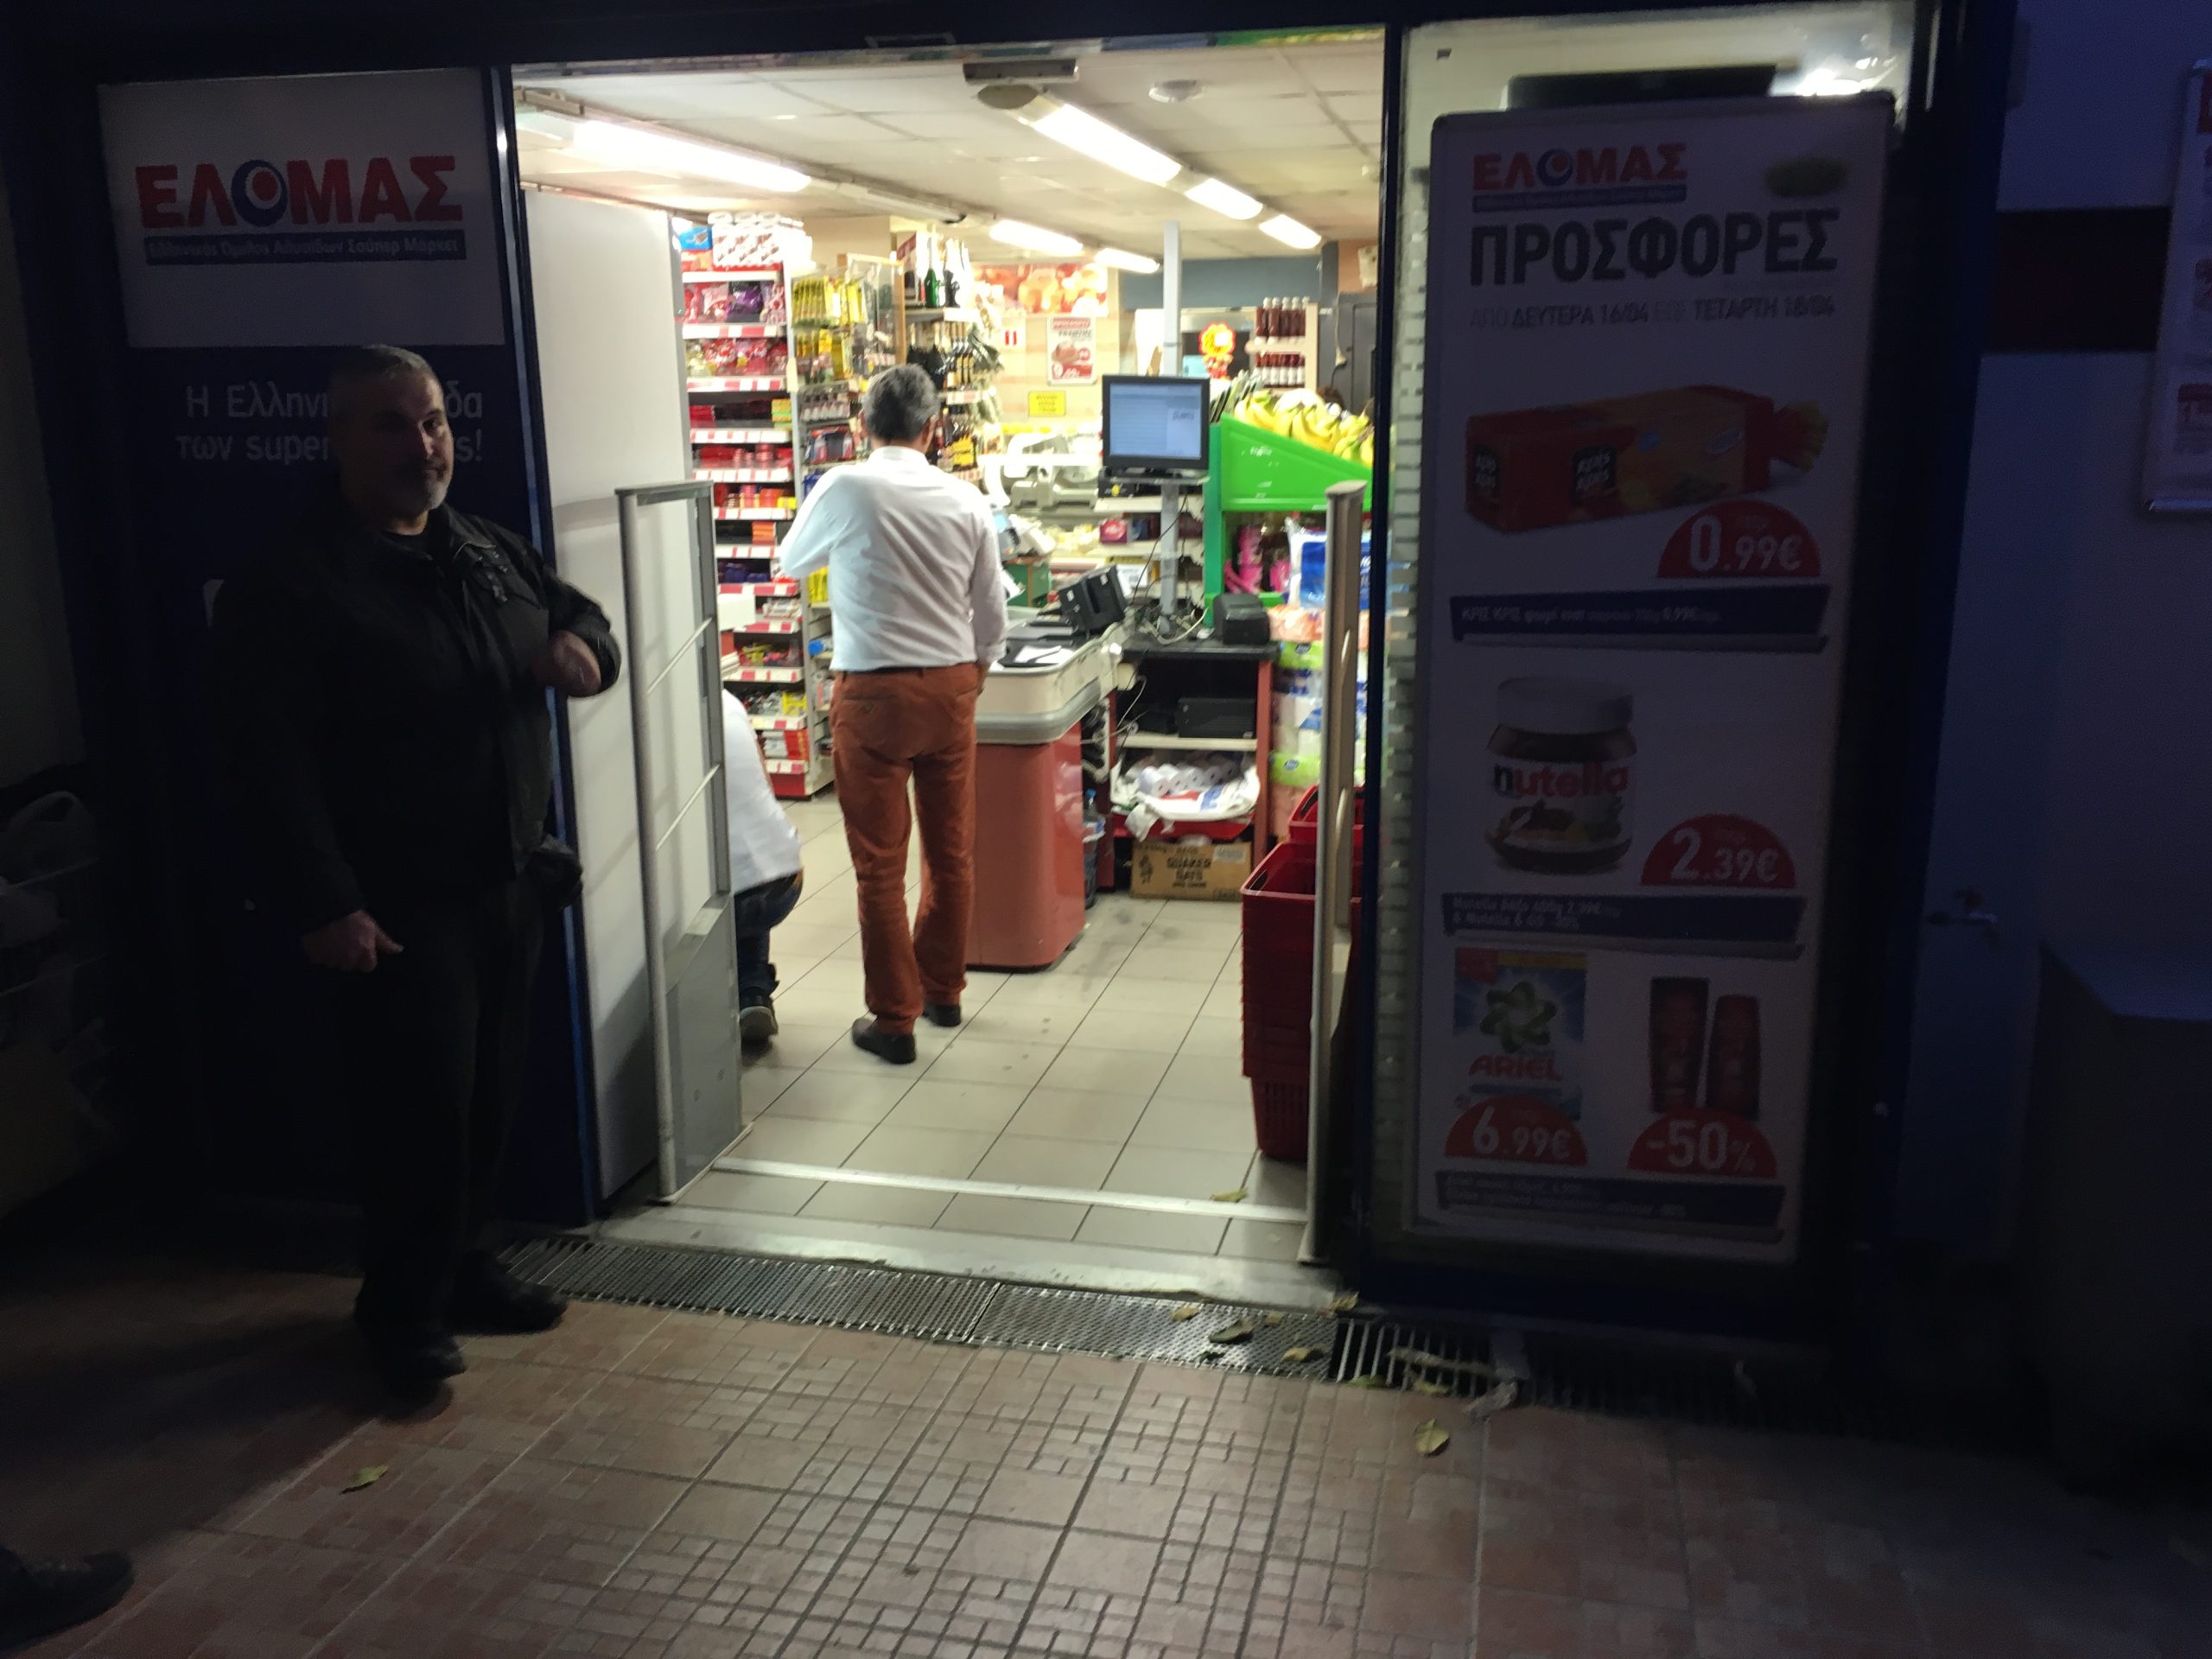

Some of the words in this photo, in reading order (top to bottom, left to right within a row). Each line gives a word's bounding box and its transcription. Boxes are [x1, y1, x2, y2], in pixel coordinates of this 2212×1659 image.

[1472, 143, 1688, 191] ΕΛΟΜΑΣ
[136, 156, 463, 229] ΕΛΟΜΑΣ
[1470, 208, 1840, 287] ΠΡΟΣΦΟΡΕΣ
[1511, 304, 1594, 328] ΔΕΥΤΕΡΑ
[1694, 296, 1778, 321] ΤΕΤΑΡΤΗ
[186, 385, 209, 418] Η
[227, 380, 328, 418] Ελληνι
[175, 435, 233, 461] των
[1493, 760, 1629, 798] nutella
[1468, 1054, 1563, 1083] ARIEL
[1646, 1121, 1758, 1173] -50%
